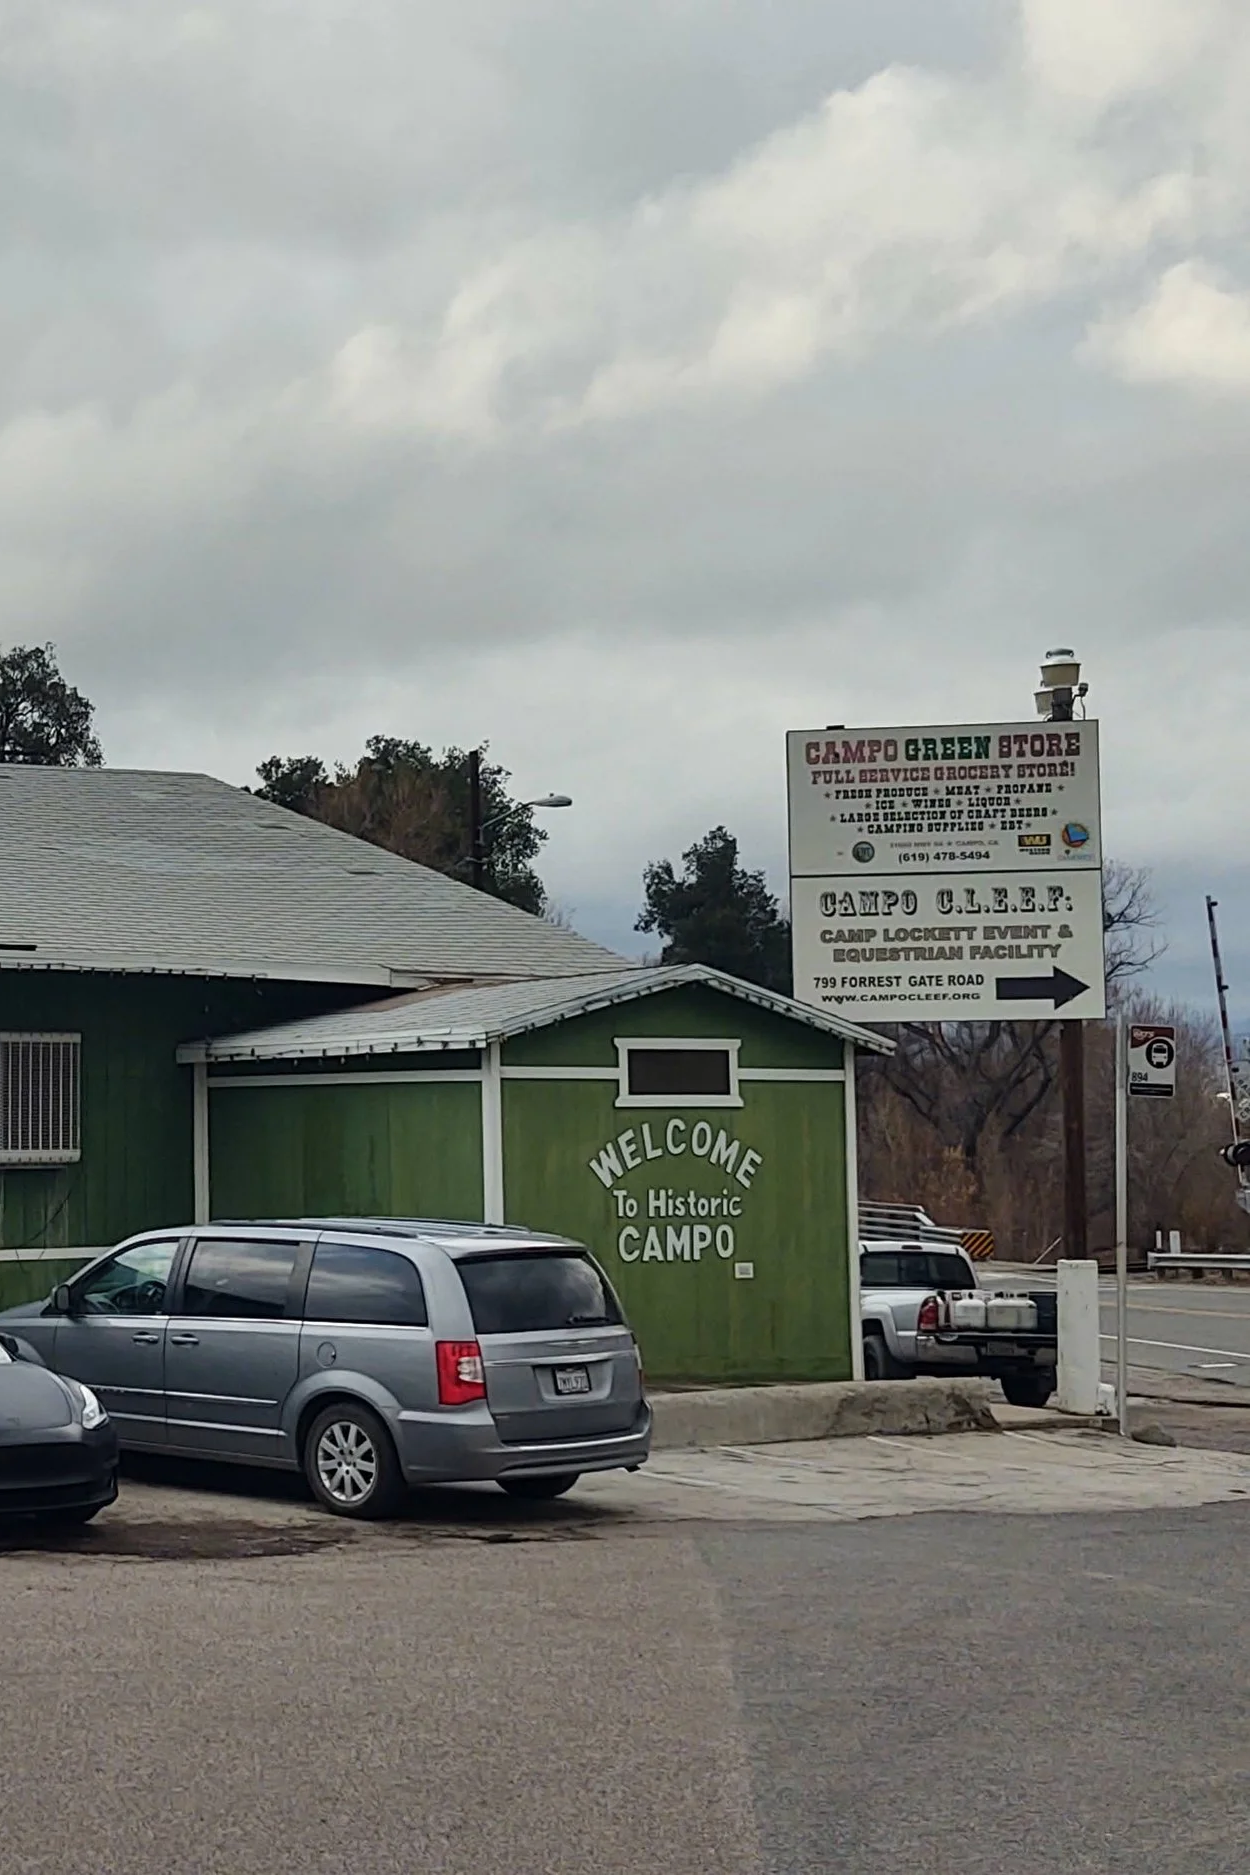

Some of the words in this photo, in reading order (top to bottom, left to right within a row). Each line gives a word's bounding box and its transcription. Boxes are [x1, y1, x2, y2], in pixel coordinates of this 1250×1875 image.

[805, 739, 898, 765] CAMPO
[904, 736, 991, 761] GREEN
[998, 732, 1080, 758] STORE
[811, 770, 855, 785] FULL
[859, 767, 930, 783] SERVICE
[934, 764, 1013, 780] GROCERY
[1016, 761, 1075, 778] STORE!
[835, 789, 872, 800] FRESH
[876, 787, 928, 799] PRODUCE
[945, 785, 980, 796] MEAT
[997, 783, 1052, 794] PROFANE
[875, 800, 895, 810] ICE
[911, 798, 951, 809] WINES
[968, 796, 1011, 808] LIQUOR
[840, 812, 880, 823] LARGE
[883, 810, 947, 822] SELECTION
[950, 809, 964, 820] OF
[967, 808, 1007, 819] CRAFT
[1010, 807, 1048, 818] BEERS
[867, 823, 924, 834] CAMPING
[927, 821, 984, 832] SUPPLIES
[1000, 820, 1023, 830] EBT
[898, 852, 930, 864] (619)
[933, 850, 990, 861] 478-5494
[820, 889, 918, 917] CAMPO
[820, 929, 877, 943] CAMP
[882, 926, 977, 942] LOCKETT
[983, 925, 1052, 940] EVENT
[1057, 924, 1073, 939] &
[833, 946, 963, 963] EQUESTRIAN
[969, 944, 1062, 960] FACILITY
[813, 976, 837, 989] 799
[841, 975, 902, 988] FORREST
[908, 975, 944, 987] GATE
[947, 974, 985, 986] ROAD
[1131, 1071, 1149, 1082] 894
[588, 1117, 763, 1189] WELCOME
[612, 1189, 638, 1217] To
[648, 1188, 743, 1217] Historic
[618, 1224, 735, 1262] CAMPO
